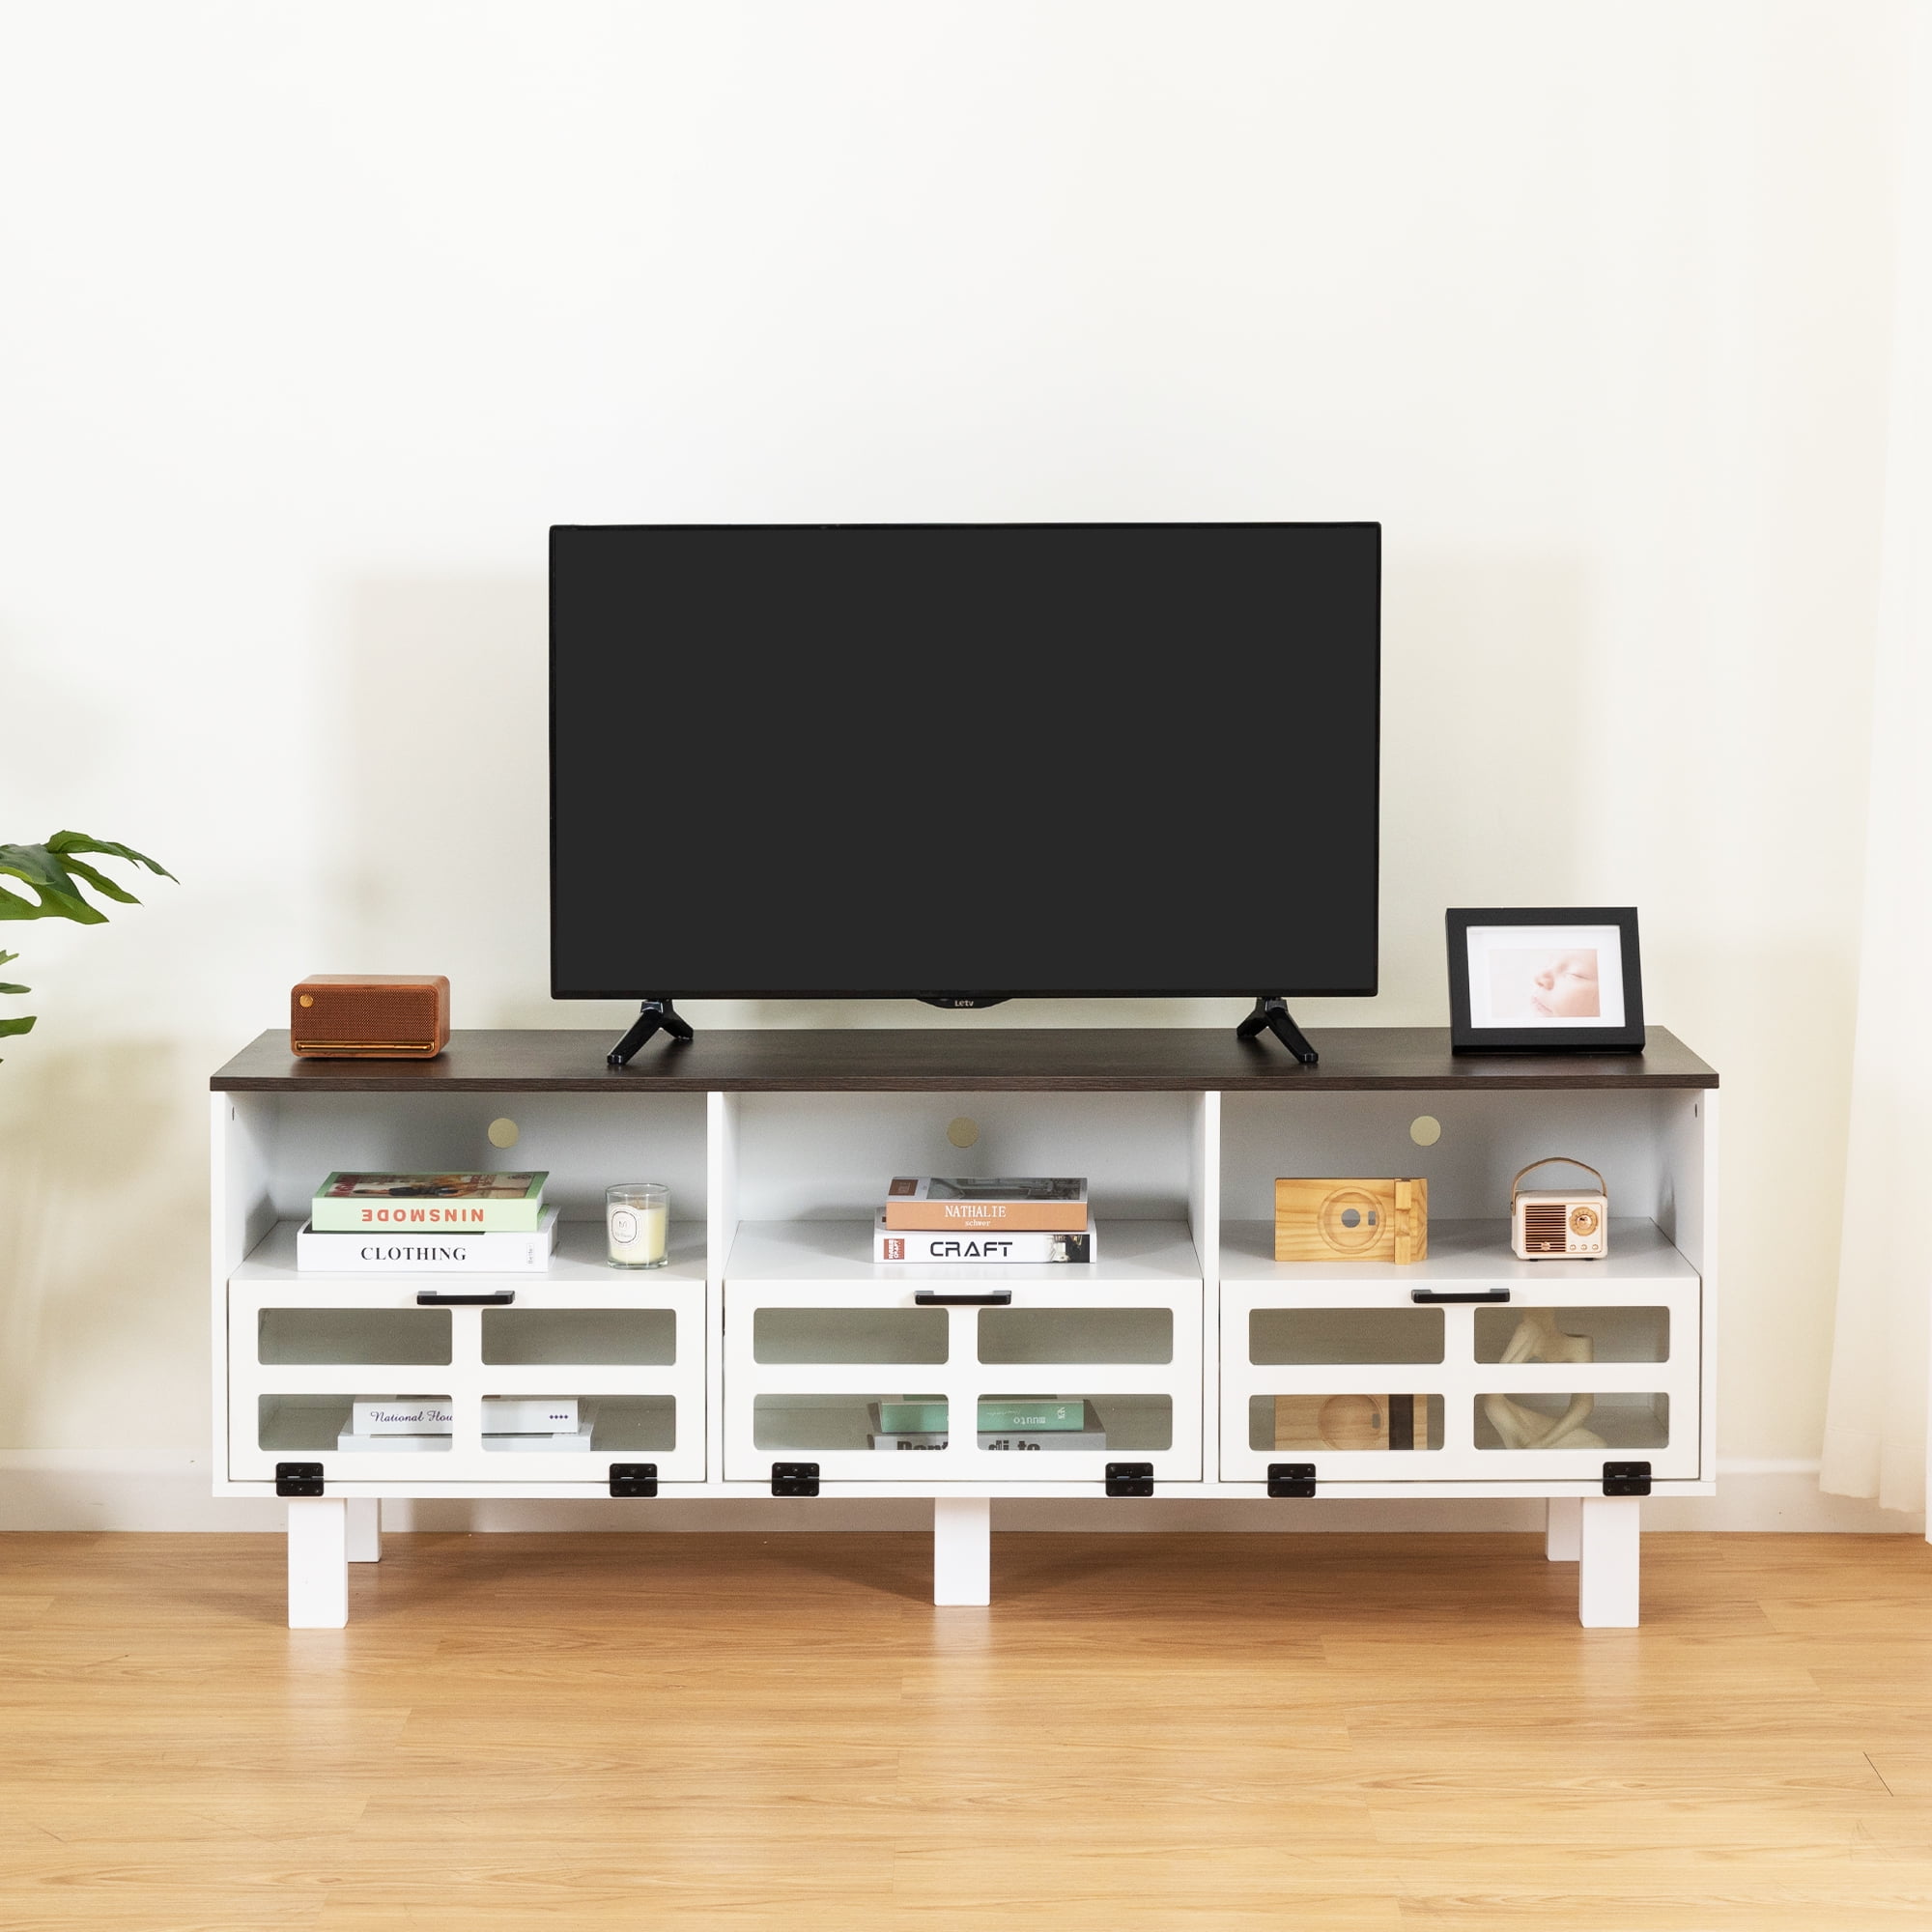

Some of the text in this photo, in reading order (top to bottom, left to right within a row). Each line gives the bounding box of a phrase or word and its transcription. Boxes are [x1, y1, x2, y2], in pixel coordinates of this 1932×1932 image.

[361, 1208, 484, 1222] NINSMODE
[945, 1206, 1007, 1218] NATHALIE
[360, 1246, 467, 1262] CLOTHING
[930, 1241, 1013, 1257] CRAFT
[371, 1410, 424, 1422] National
[1013, 1416, 1046, 1425] muuto
